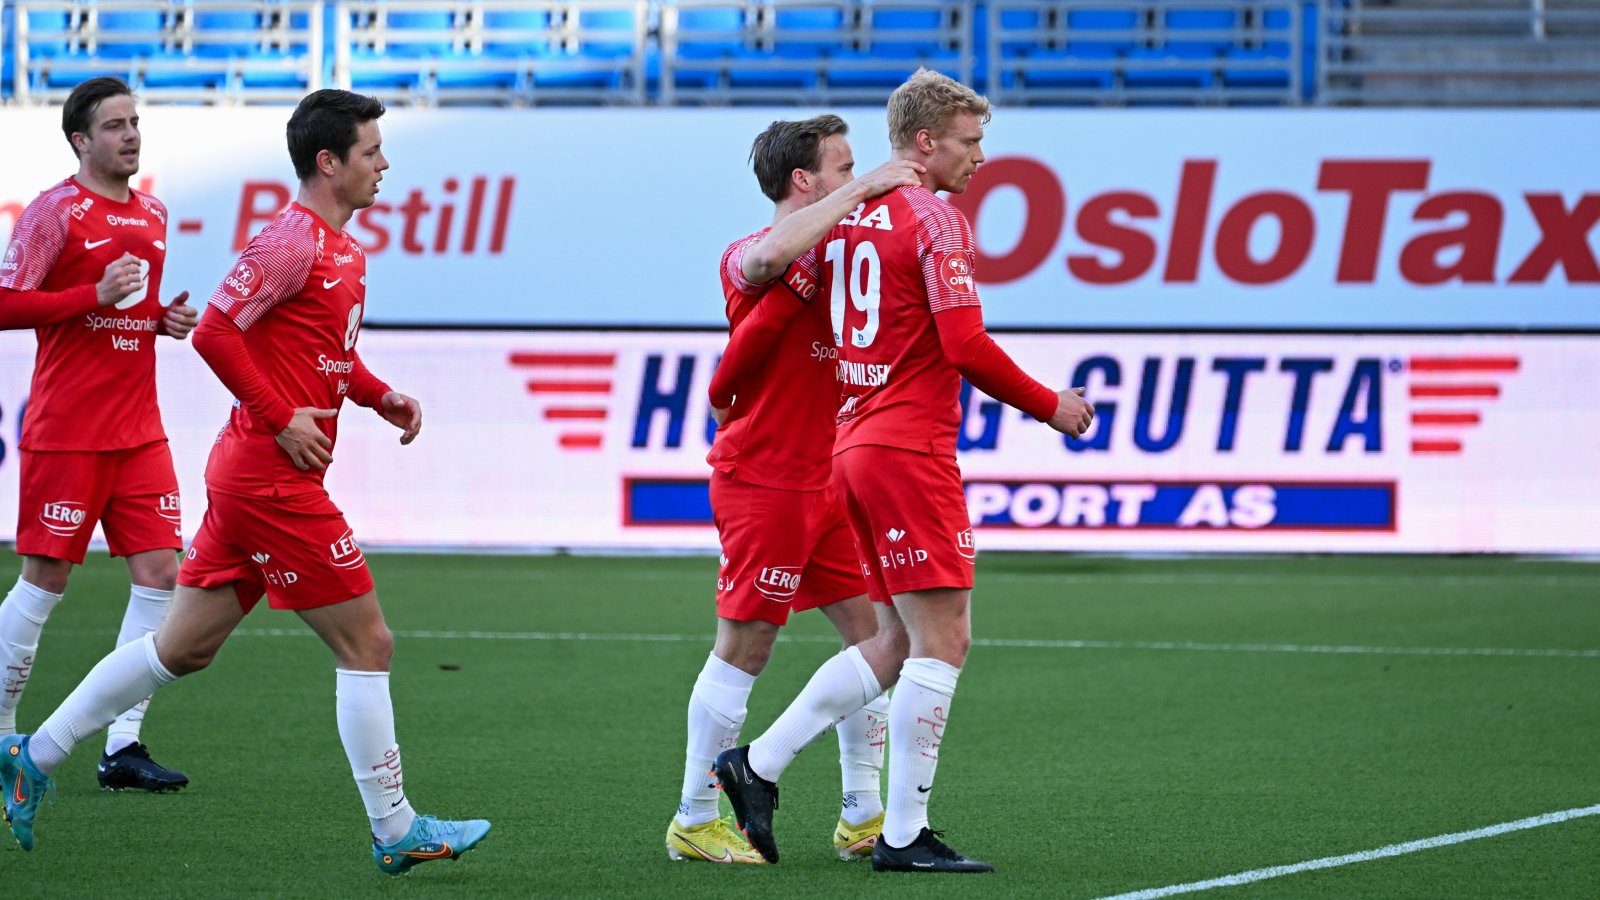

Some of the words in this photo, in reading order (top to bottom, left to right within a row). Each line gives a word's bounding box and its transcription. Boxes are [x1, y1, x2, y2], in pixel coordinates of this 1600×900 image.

[231, 176, 516, 256] Bstill
[957, 156, 1600, 286] OsloTax
[225, 275, 251, 298] OBOS
[788, 271, 818, 302] MO
[824, 238, 882, 349] 19
[111, 334, 140, 352] Vest
[966, 484, 1156, 528] PORT
[1177, 484, 1277, 529] AS
